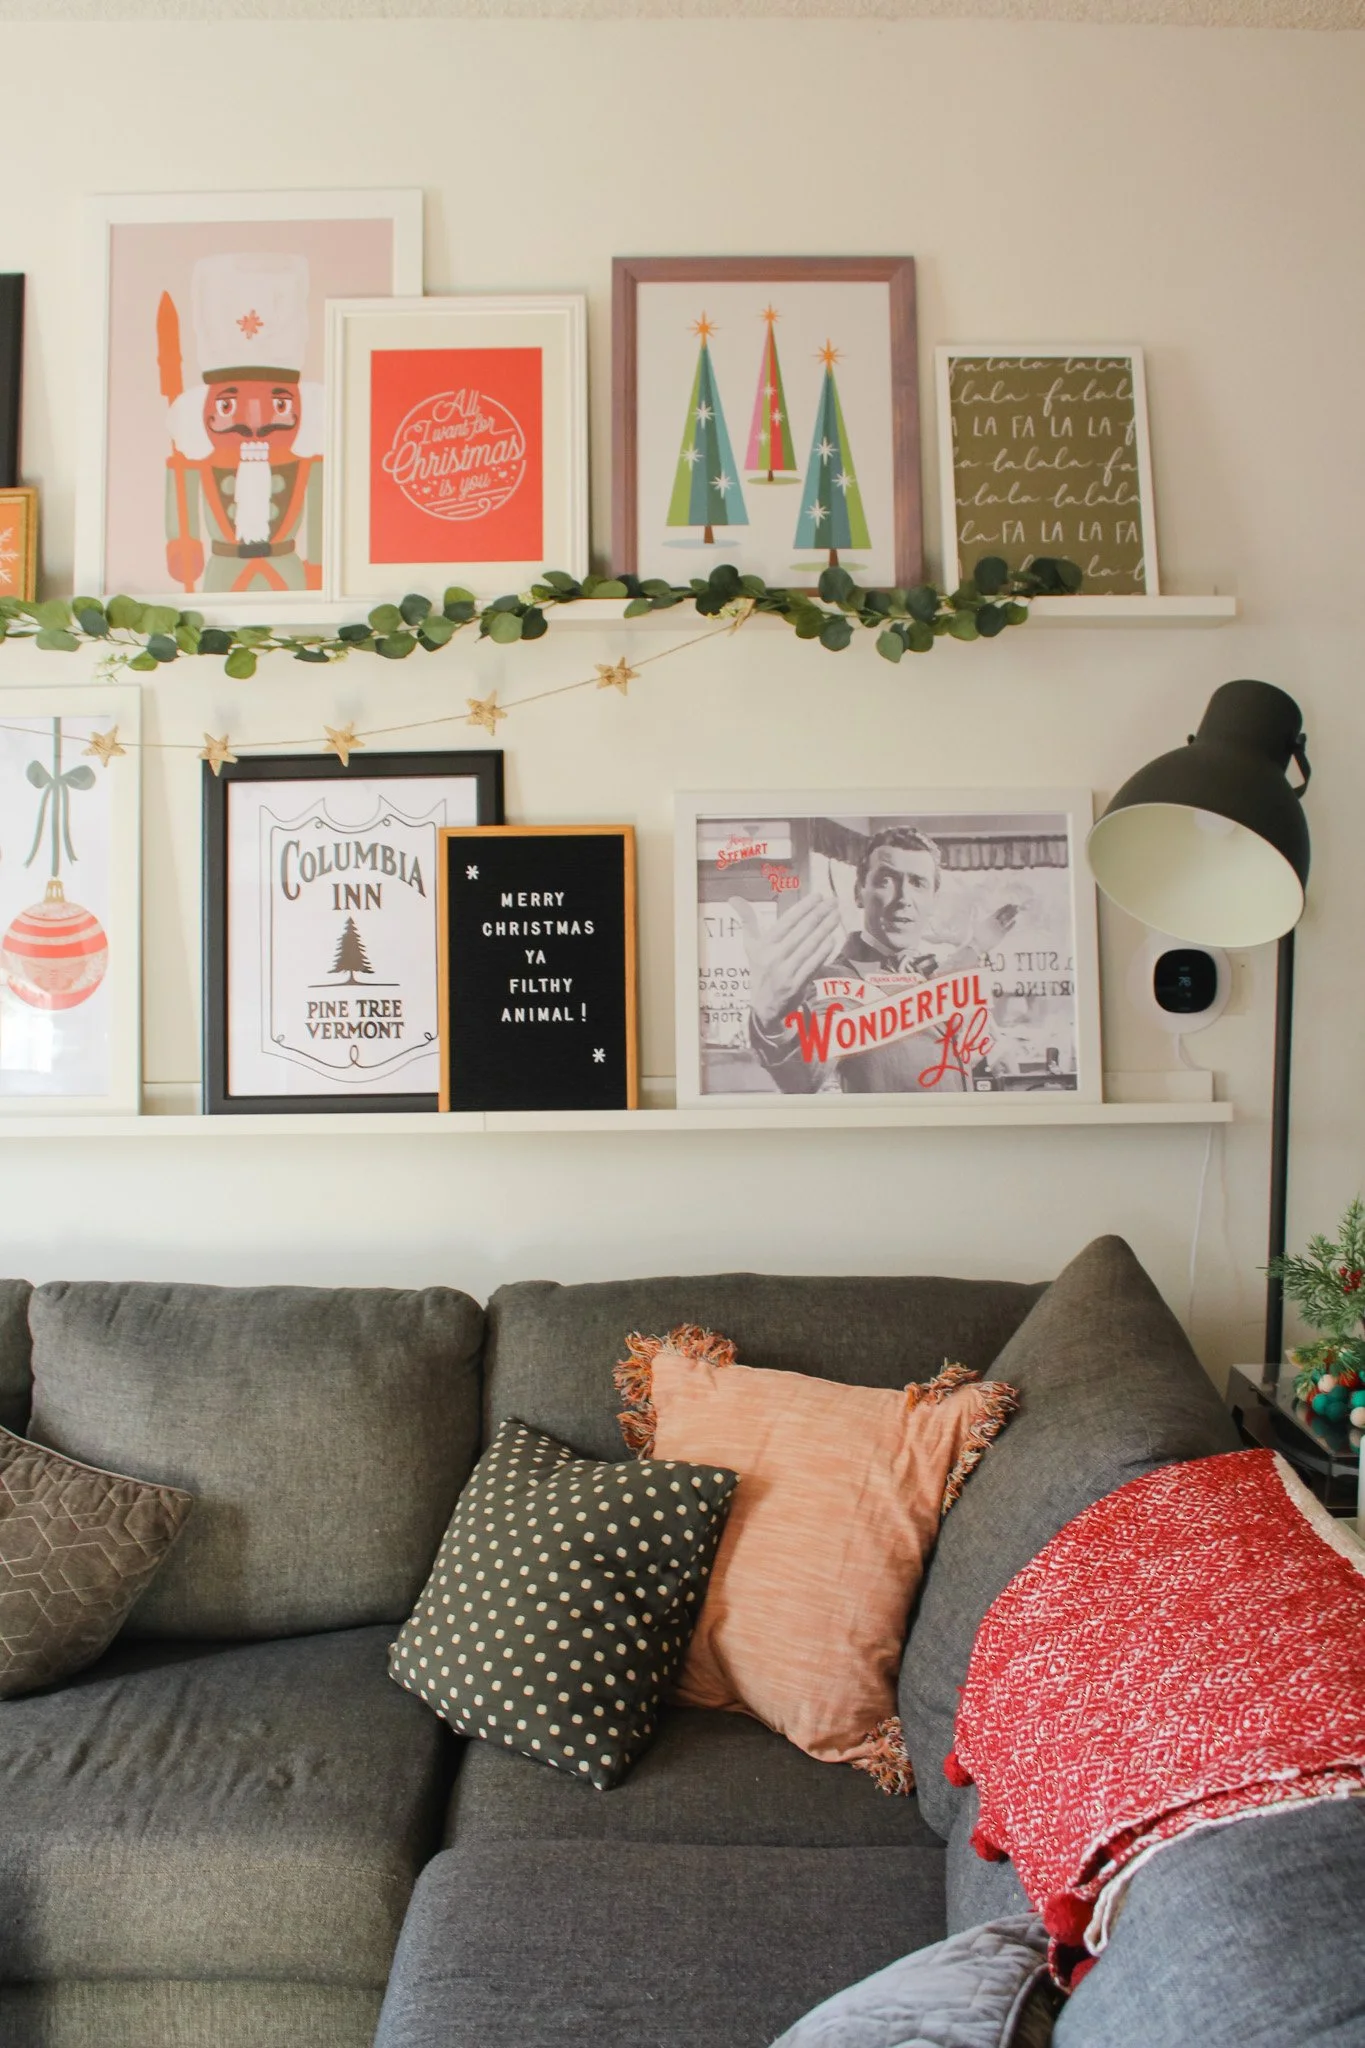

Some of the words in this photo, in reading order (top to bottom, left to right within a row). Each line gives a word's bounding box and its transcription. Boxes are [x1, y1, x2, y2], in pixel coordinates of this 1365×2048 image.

[432, 388, 481, 423] All
[403, 419, 432, 445] I
[432, 419, 470, 442] want
[466, 413, 515, 442] for
[973, 416, 998, 437] LA
[1012, 416, 1035, 438] FA
[1051, 416, 1073, 438] LA
[1088, 416, 1112, 437] LA
[381, 434, 524, 485] Christmas
[438, 479, 456, 497] is
[458, 474, 492, 501] you
[1002, 520, 1026, 544] FA
[1041, 520, 1064, 543] LA
[1078, 520, 1103, 542] LA
[1115, 520, 1138, 544] FA
[715, 842, 768, 870] STEWART
[280, 839, 427, 901] COLUMBIA
[767, 873, 800, 893] REED
[332, 882, 383, 911] INN
[501, 892, 565, 908] MERRY
[482, 920, 595, 937] CHRISTMAS
[525, 949, 547, 965] YA
[509, 978, 573, 994] FILTHY
[823, 980, 851, 996] IT'S
[854, 985, 866, 999] A
[306, 1000, 349, 1018] PINE
[355, 999, 403, 1018] TREE
[784, 974, 988, 1064] WONDERFUL
[304, 1020, 405, 1040] VERMONT
[917, 1006, 996, 1089] Life
